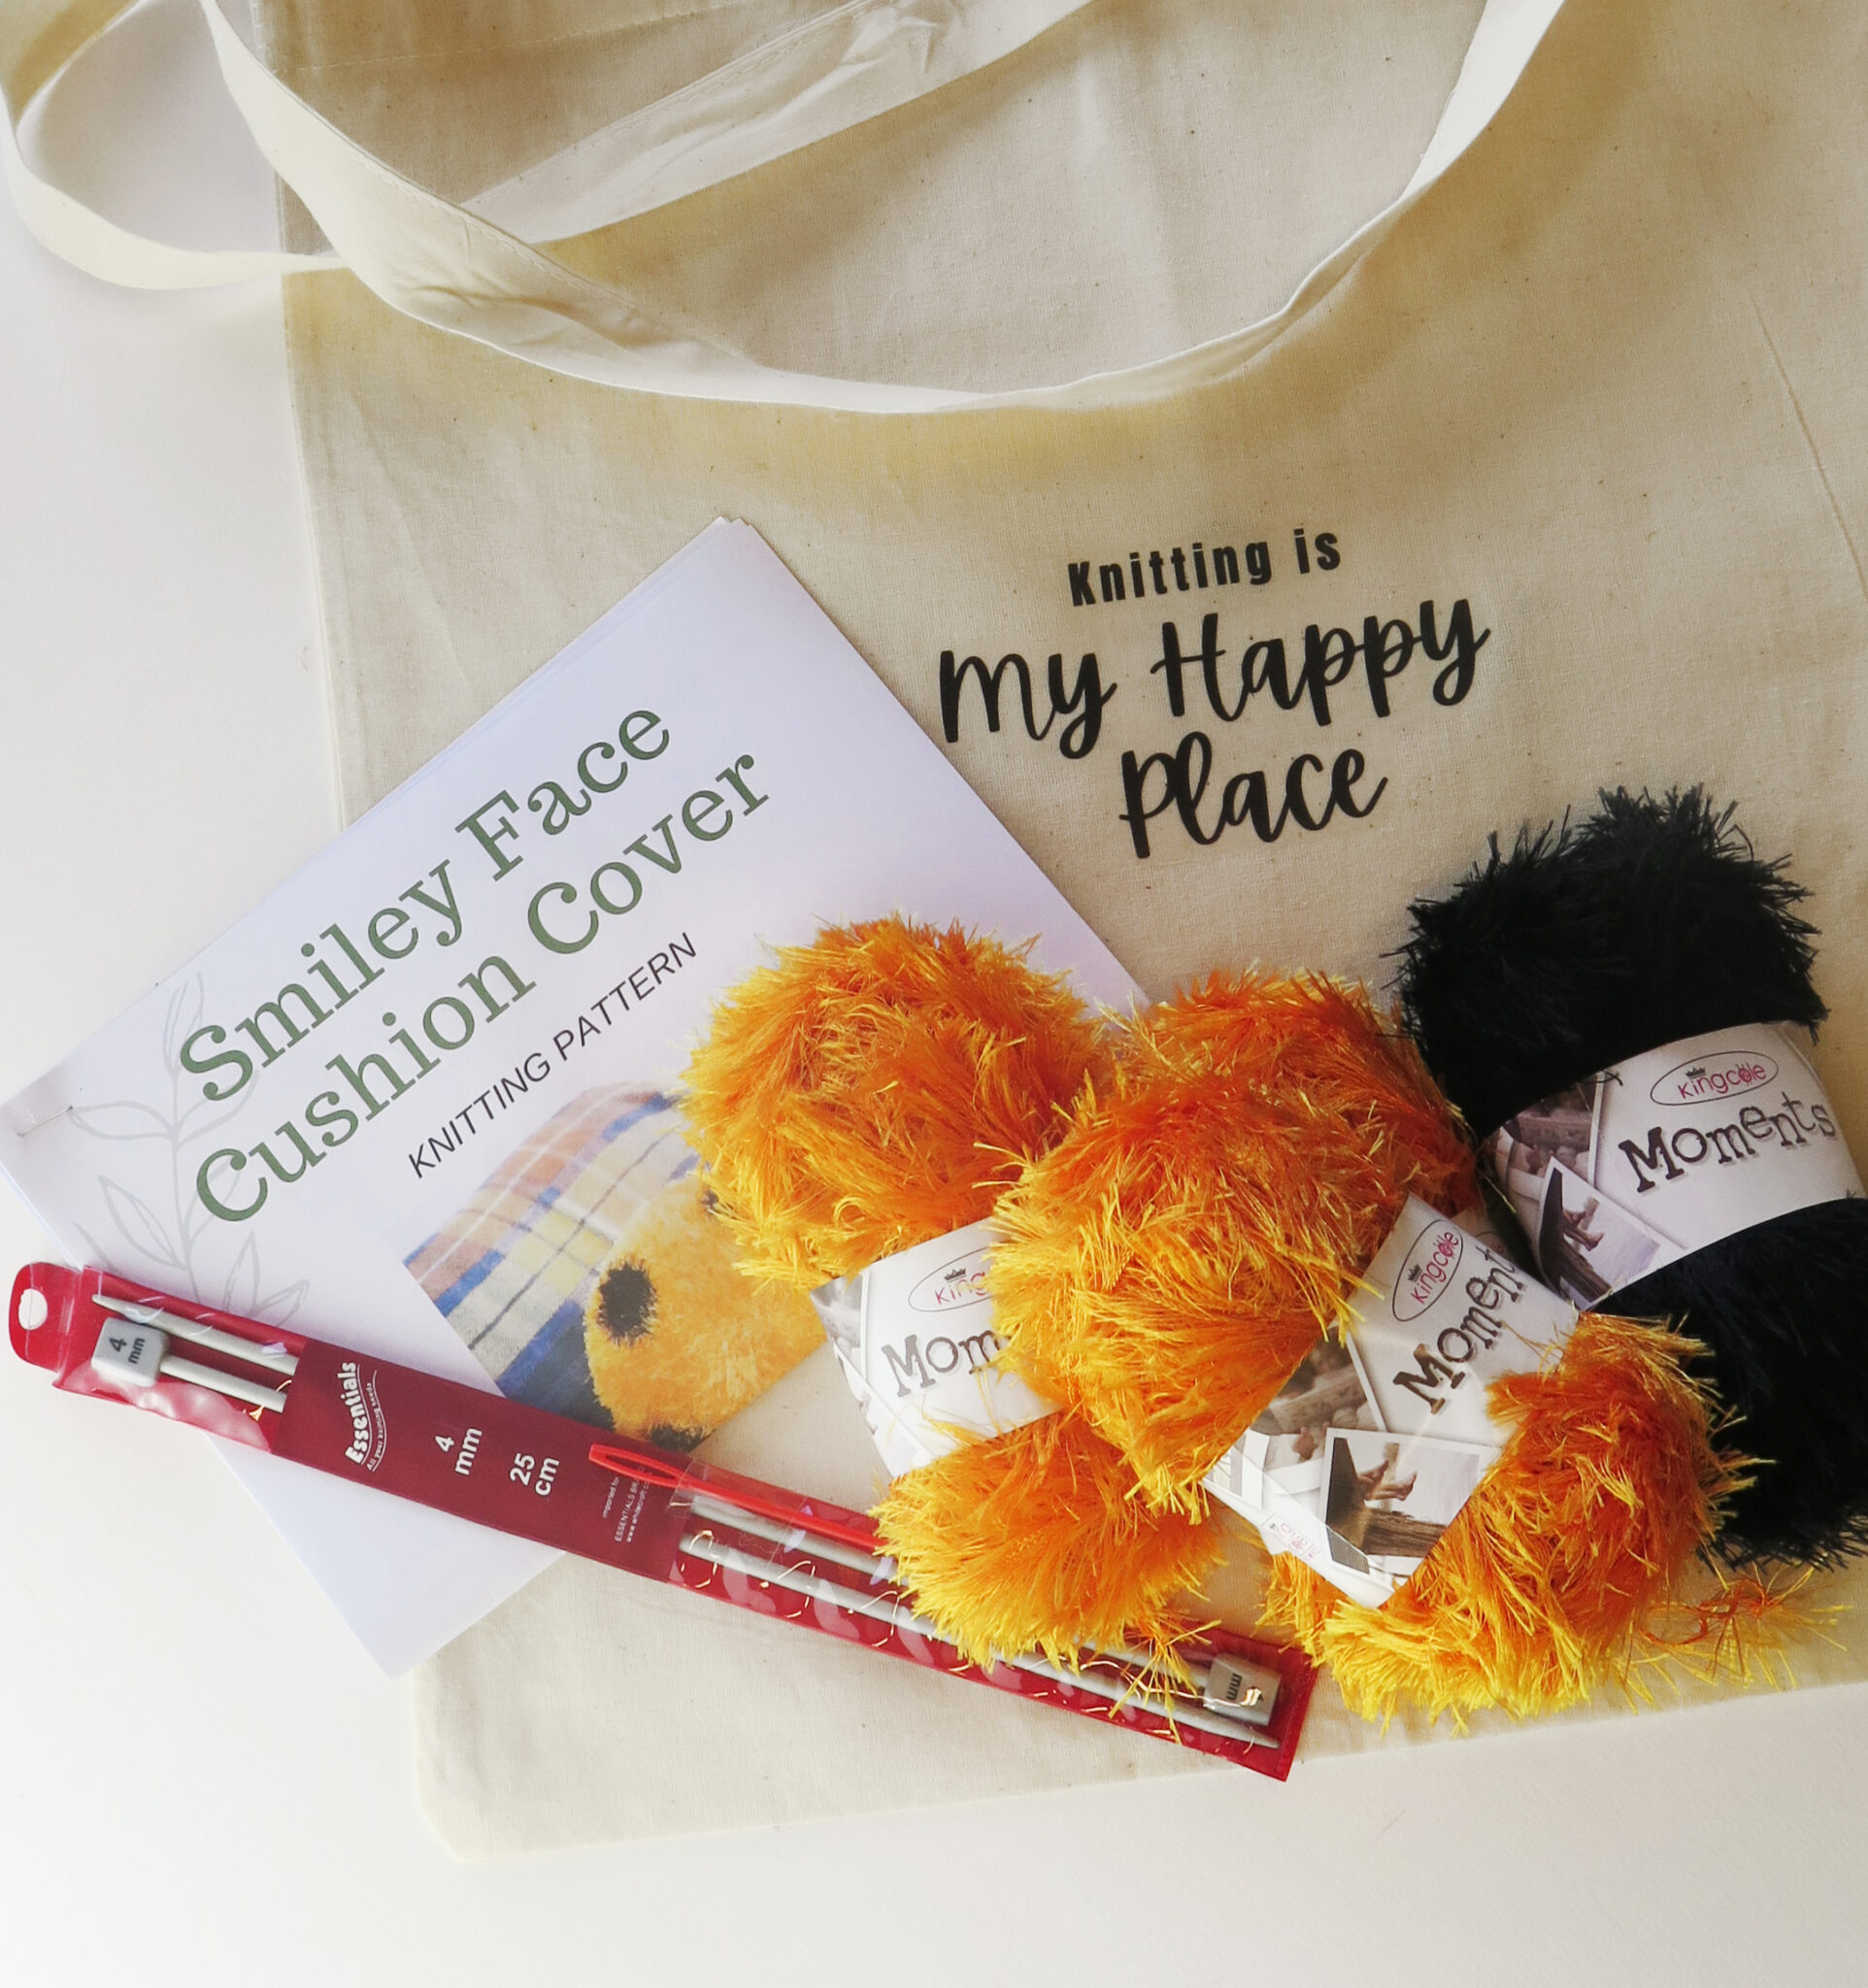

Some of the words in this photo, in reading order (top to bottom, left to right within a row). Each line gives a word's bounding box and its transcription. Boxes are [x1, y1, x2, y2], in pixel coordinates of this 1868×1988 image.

[1068, 541, 1273, 607] Knitting
[1294, 527, 1342, 575] is
[1151, 599, 1491, 726] Happy
[1119, 731, 1388, 858] Place
[180, 860, 464, 1102] Smiley
[455, 709, 670, 881] Face
[196, 954, 537, 1222] Cushion
[527, 753, 770, 955] Cover
[407, 1051, 551, 1179] KNITTING
[552, 932, 699, 1062] PATTERN
[1618, 1091, 1838, 1195] Moments
[108, 1337, 128, 1352] 4
[127, 1337, 146, 1365] mm
[881, 1329, 1012, 1398] Mom
[336, 1362, 370, 1464] Essentials
[366, 1458, 377, 1471] All
[374, 1441, 384, 1459] your
[434, 1435, 454, 1452] 4
[454, 1428, 483, 1475] mm
[509, 1452, 535, 1486] 25
[535, 1458, 560, 1496] cm
[614, 1494, 636, 1542] ESSENTIALS
[1226, 1673, 1243, 1701] mm
